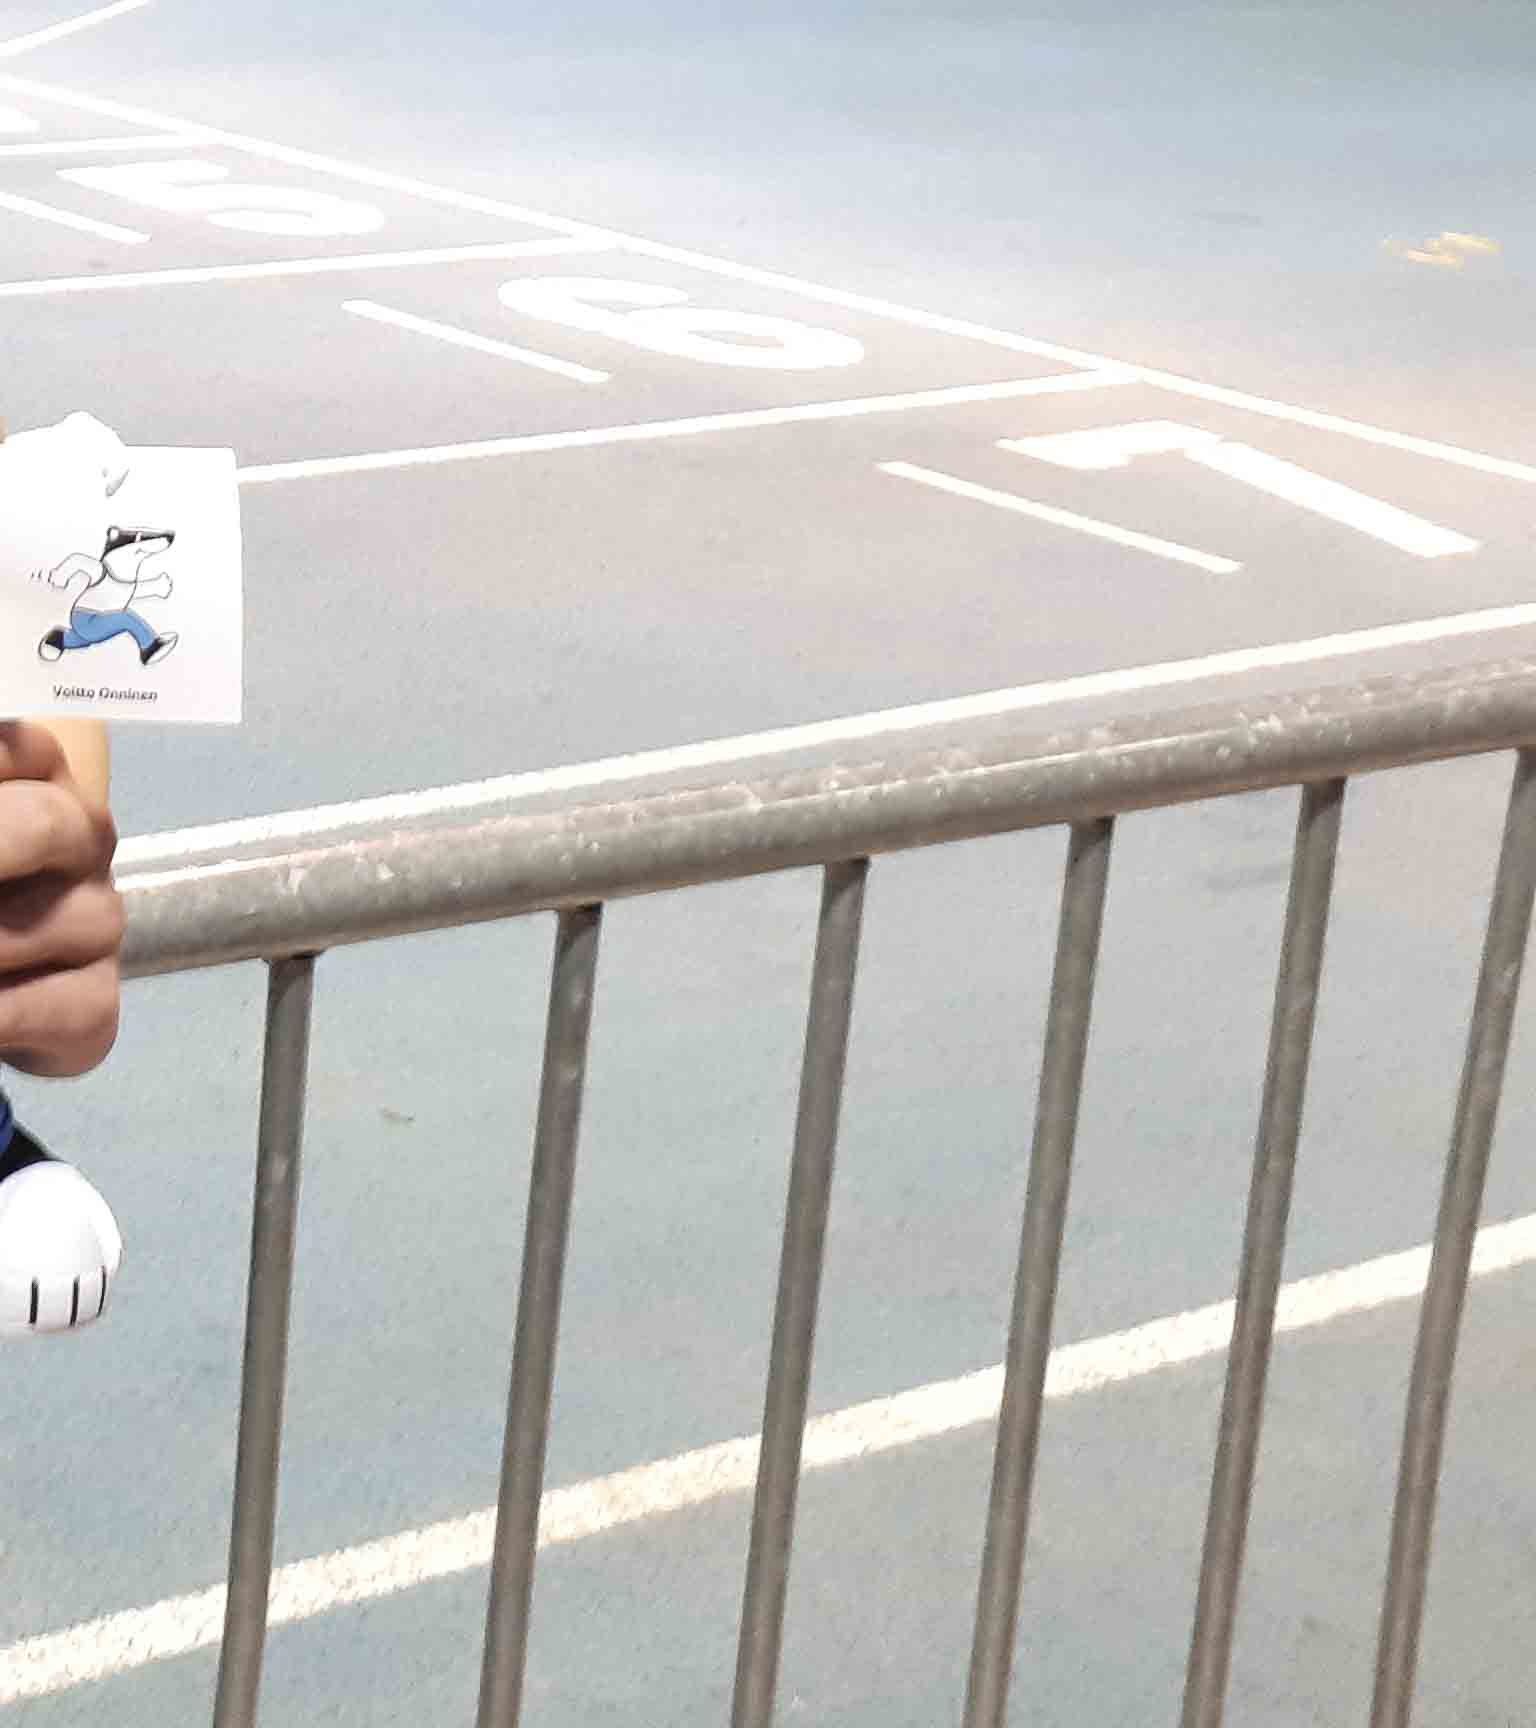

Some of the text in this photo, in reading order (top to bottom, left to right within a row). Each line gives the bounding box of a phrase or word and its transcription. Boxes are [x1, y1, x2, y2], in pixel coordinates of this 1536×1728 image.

[55, 159, 387, 236] 5
[498, 275, 866, 370] 6
[994, 419, 1481, 558] 7
